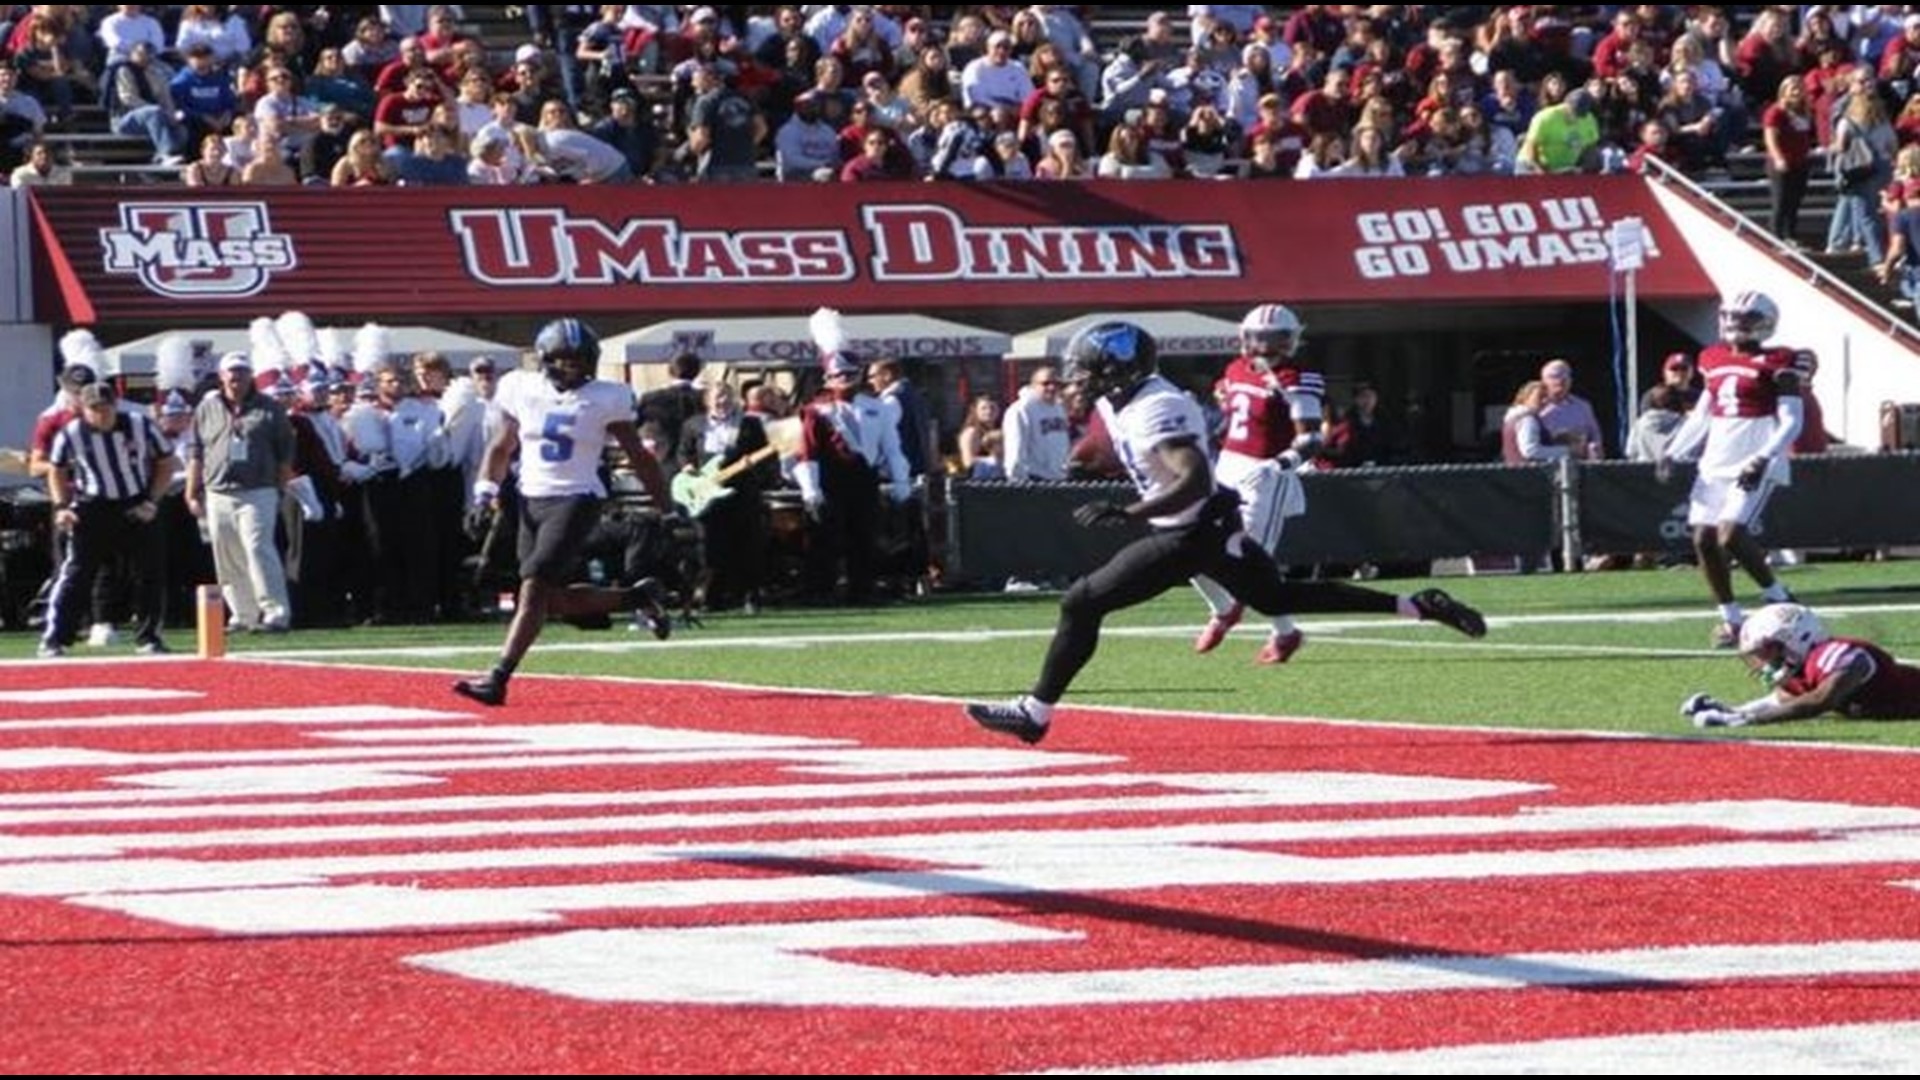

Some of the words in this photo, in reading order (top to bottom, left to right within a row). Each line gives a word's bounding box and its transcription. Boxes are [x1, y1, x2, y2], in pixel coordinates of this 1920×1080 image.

[862, 204, 1241, 281] DINING
[1356, 207, 1450, 243] GO!
[1463, 203, 1538, 236] GO
[1541, 196, 1604, 230] U!
[1355, 244, 1431, 279] GO
[1438, 226, 1661, 272] UMAS!
[749, 336, 985, 359] CONESSIONS
[1227, 392, 1251, 440] 2
[1716, 373, 1742, 416] 4
[540, 413, 576, 462] 5
